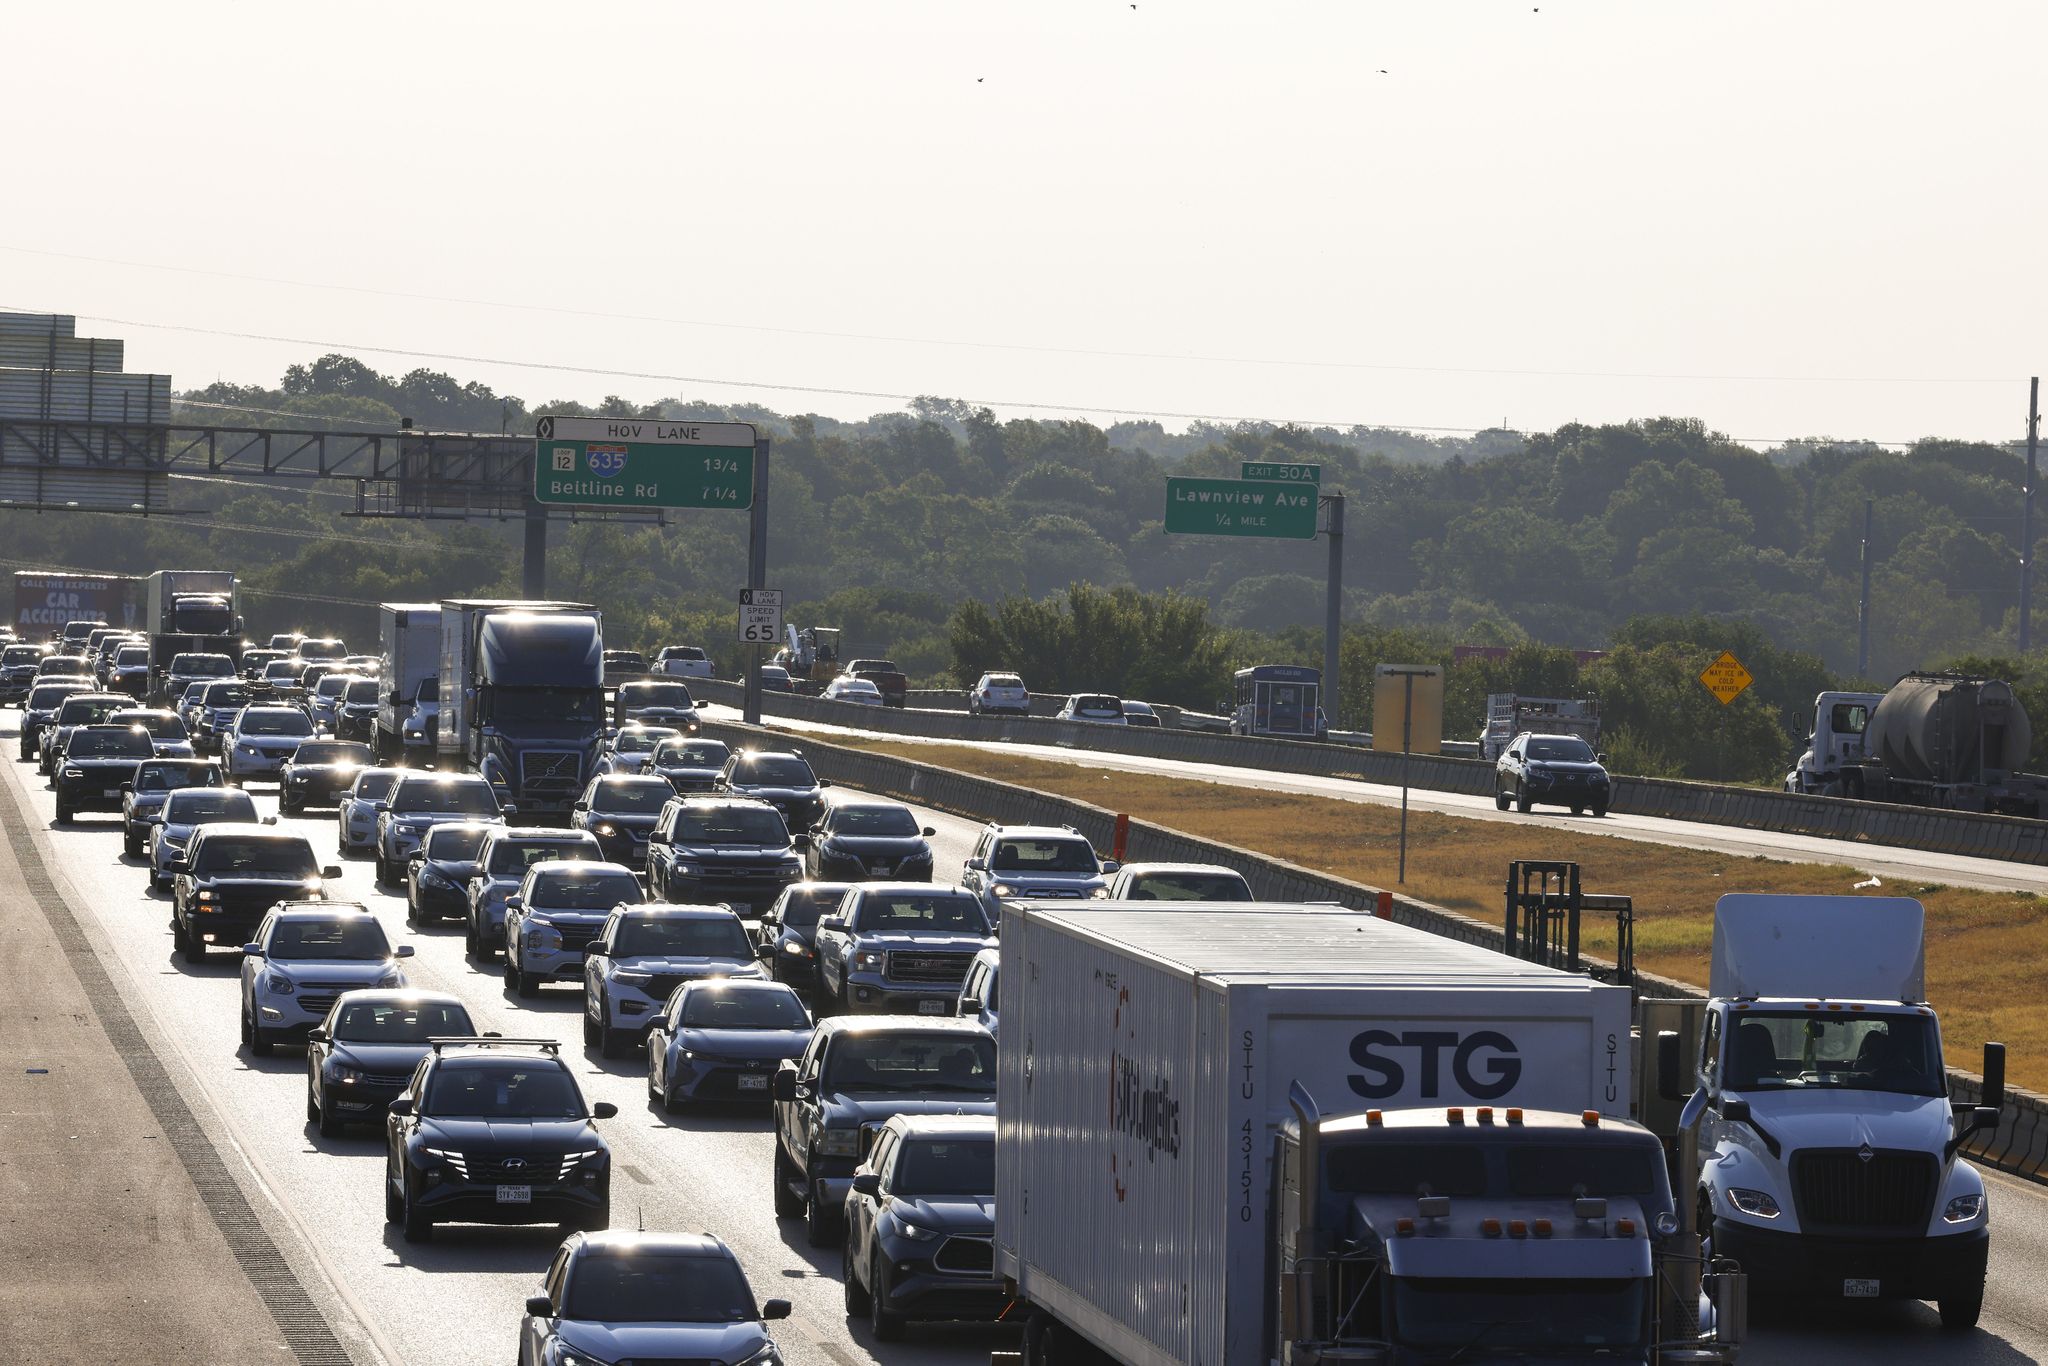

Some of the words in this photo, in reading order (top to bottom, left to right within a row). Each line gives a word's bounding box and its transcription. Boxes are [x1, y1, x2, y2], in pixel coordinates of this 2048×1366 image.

[608, 424, 642, 438] HOV
[657, 426, 700, 440] LANE
[557, 456, 571, 469] 12
[590, 452, 625, 469] 635
[1248, 467, 1273, 476] EXIT
[1279, 466, 1313, 480] 50A
[551, 481, 624, 497] Beltline
[635, 483, 658, 498] Rd
[1175, 487, 1265, 505] Lawnview
[1275, 492, 1309, 507] Ave
[1240, 516, 1267, 526] MILE
[20, 579, 44, 588] CALL
[46, 580, 64, 589] THE
[65, 581, 108, 590] EXPERTS
[46, 592, 80, 609] CAR
[18, 608, 108, 624] ACCIDENT?
[747, 607, 775, 615] SPEED
[745, 624, 774, 641] 65
[1709, 669, 1721, 677] MAY
[1242, 1030, 1254, 1100] STTU
[1346, 1029, 1522, 1100] STG
[1605, 1033, 1617, 1102] STTU
[1241, 1118, 1252, 1222] 431510
